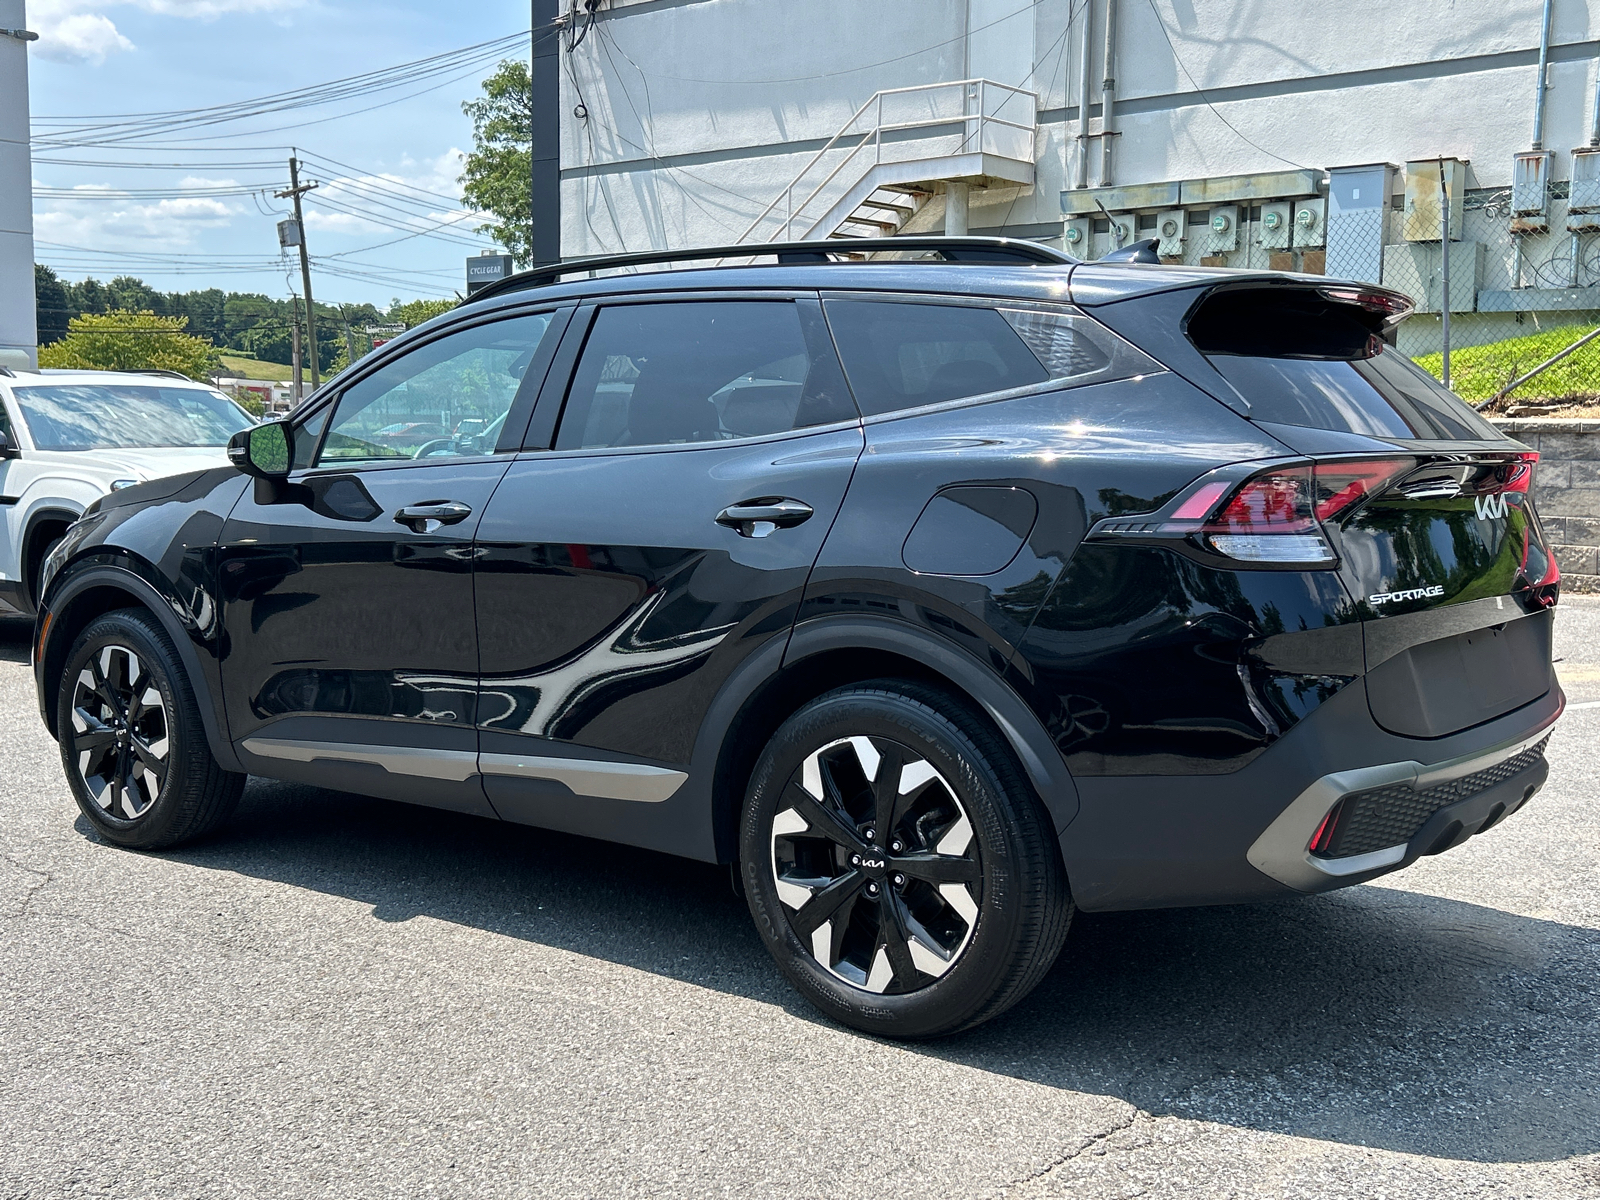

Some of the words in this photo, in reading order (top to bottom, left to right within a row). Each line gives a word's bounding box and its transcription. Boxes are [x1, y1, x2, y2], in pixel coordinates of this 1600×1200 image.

[470, 267, 486, 275] CYCLE
[487, 266, 501, 274] GEAR
[1475, 494, 1508, 521] KIA
[1369, 585, 1444, 605] SPORTAGE
[862, 859, 884, 868] KIA
[747, 861, 779, 942] KUMHO
